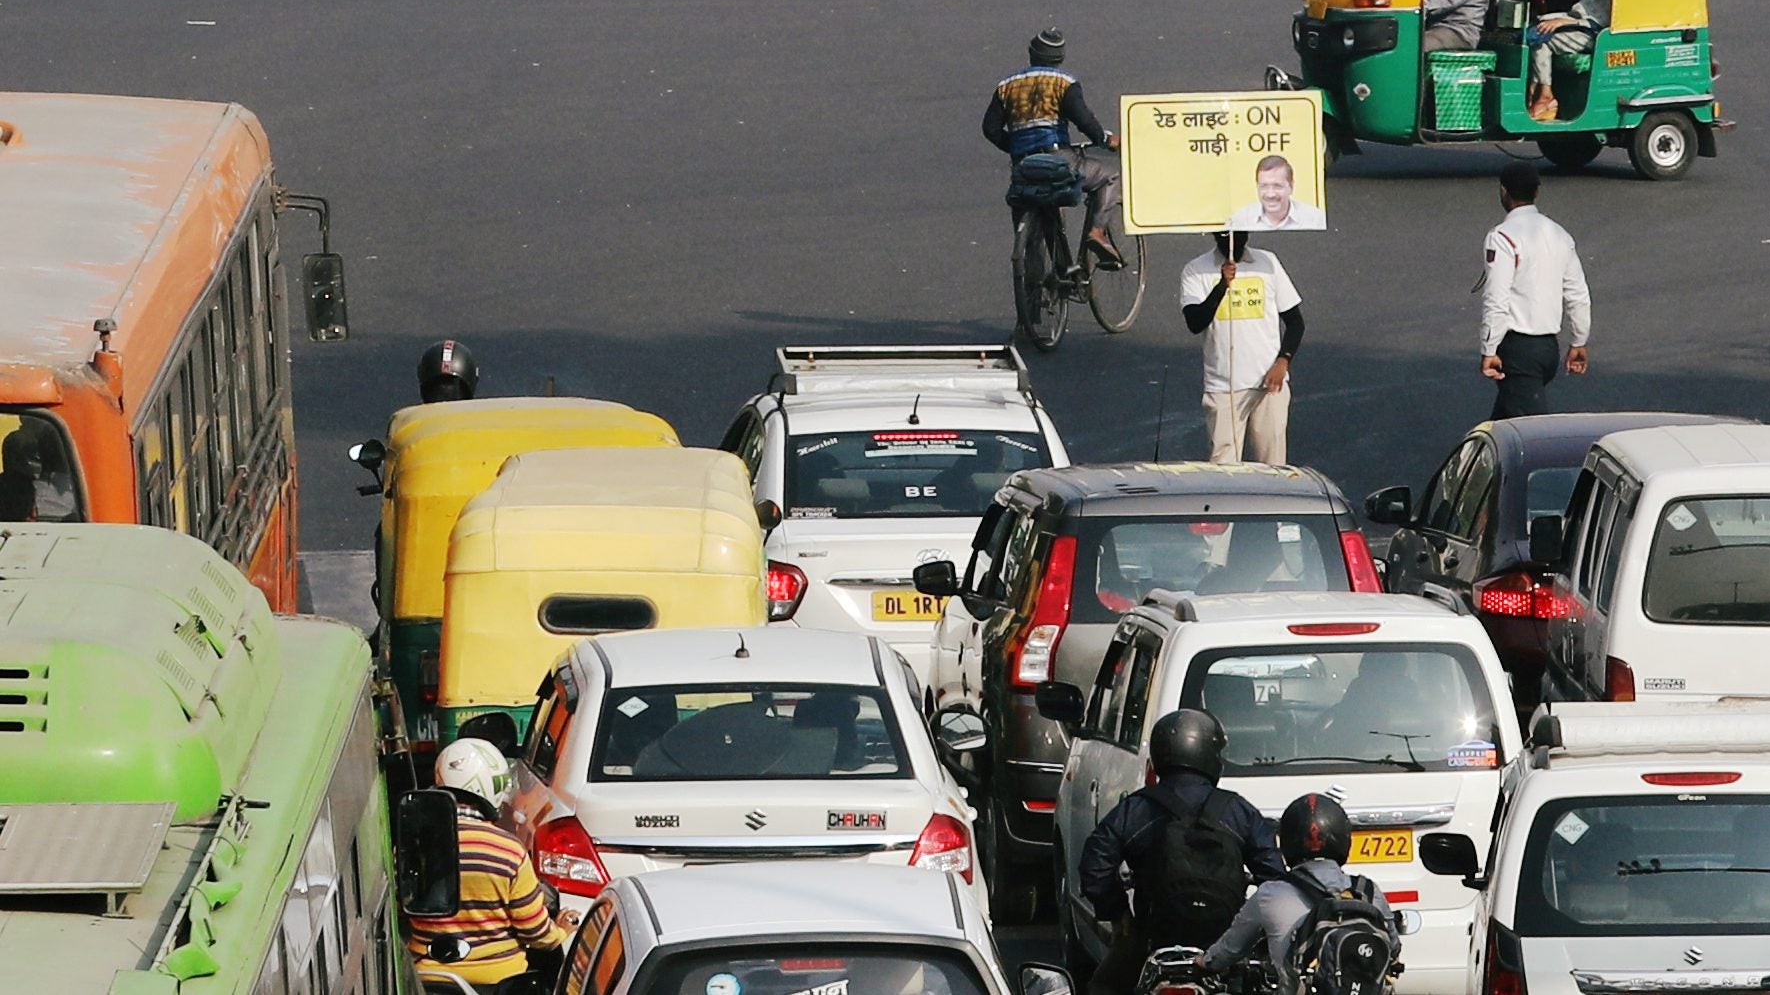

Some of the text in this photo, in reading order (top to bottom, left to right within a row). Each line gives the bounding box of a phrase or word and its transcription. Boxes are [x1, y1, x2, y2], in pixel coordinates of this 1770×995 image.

[1153, 107, 1177, 128] रेड
[1182, 111, 1229, 130] लाइट
[1246, 105, 1281, 125] ON
[1188, 134, 1229, 156] गाड़ी
[1247, 132, 1291, 153] OFF
[1671, 515, 1692, 525] CNG
[885, 596, 944, 615] DL 1RT
[828, 812, 886, 827] CHAUHAN
[1561, 822, 1583, 833] CNG
[1360, 836, 1408, 857] 4722
